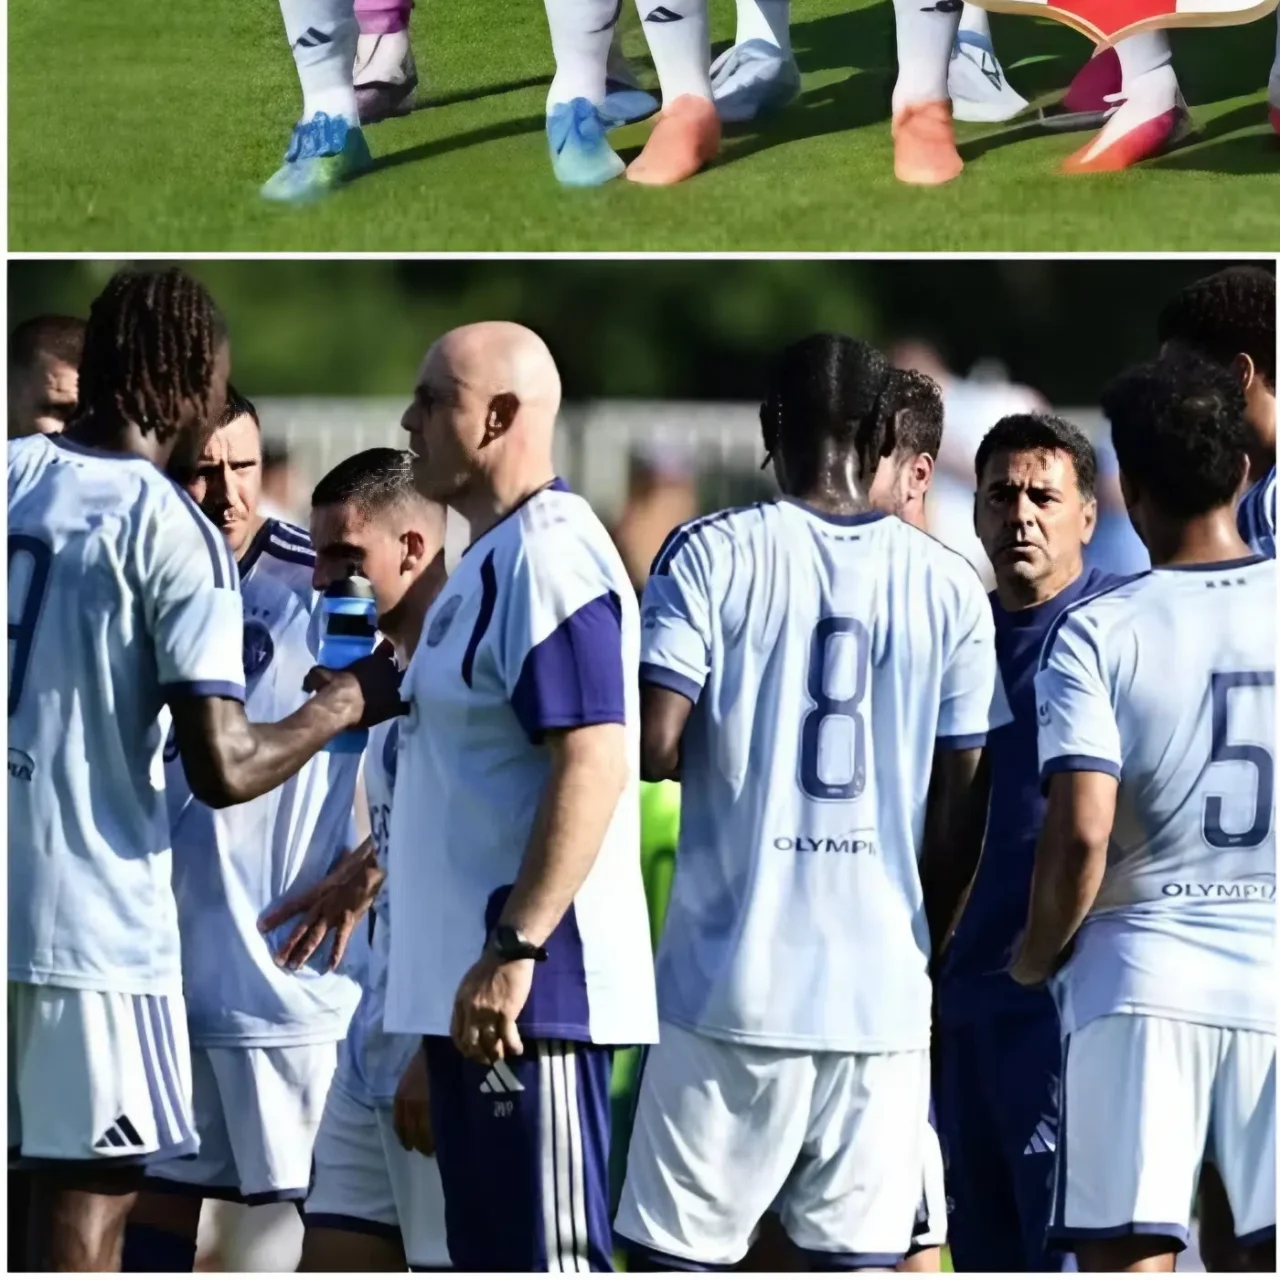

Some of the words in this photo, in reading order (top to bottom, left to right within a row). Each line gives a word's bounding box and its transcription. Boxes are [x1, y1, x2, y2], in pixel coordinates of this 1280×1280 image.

[801, 617, 870, 800] 8
[1203, 671, 1275, 848] 5
[774, 836, 875, 856] OLYMPI
